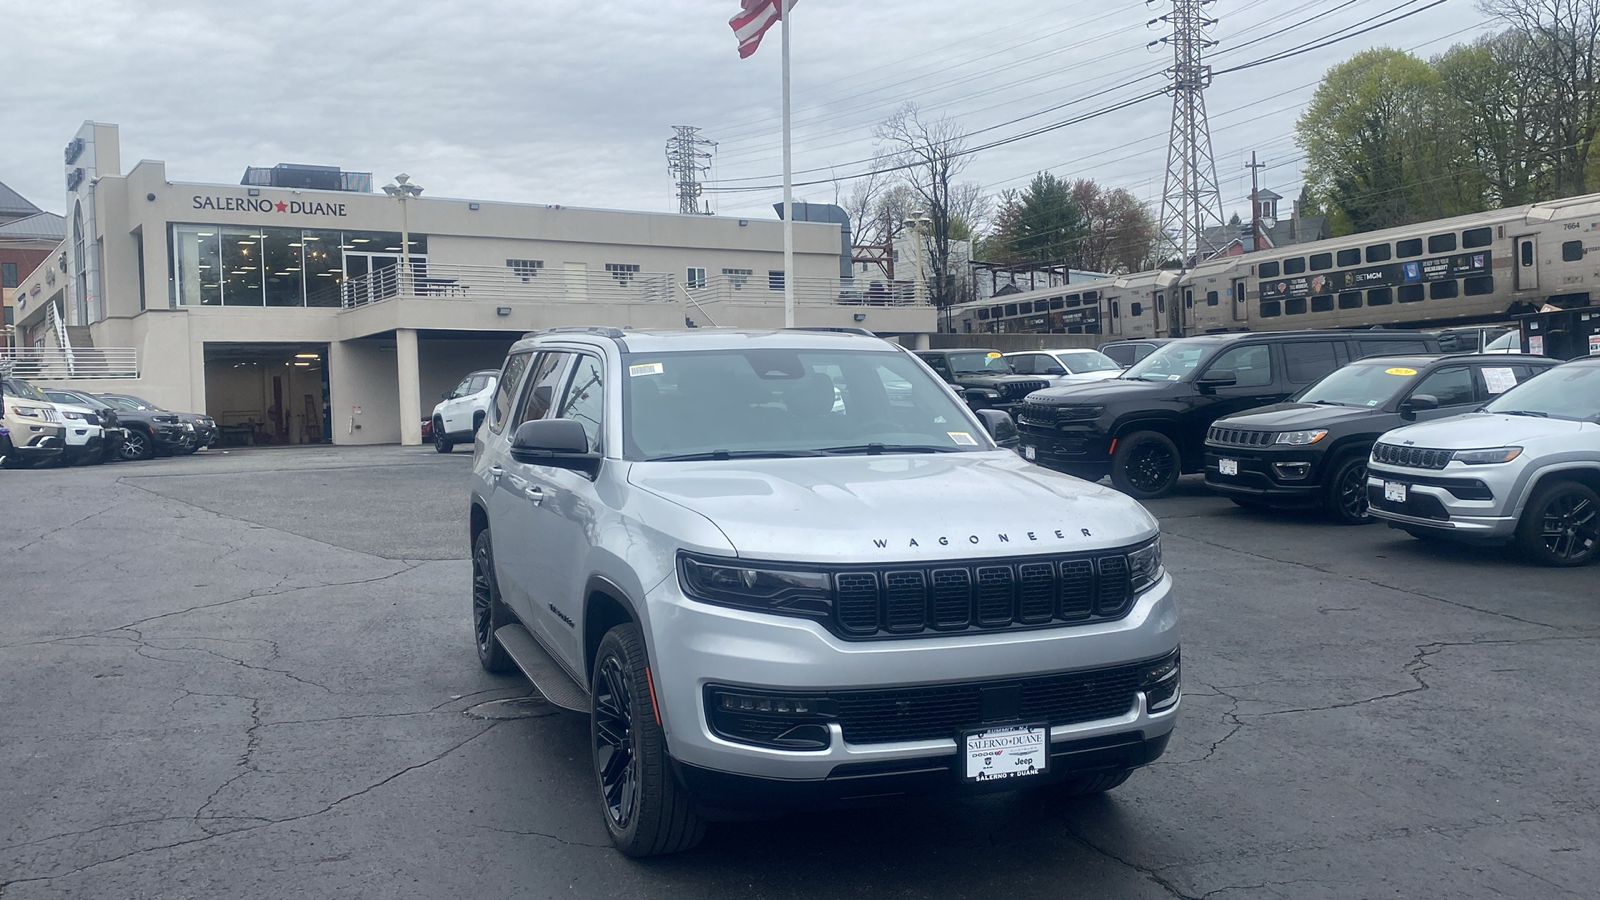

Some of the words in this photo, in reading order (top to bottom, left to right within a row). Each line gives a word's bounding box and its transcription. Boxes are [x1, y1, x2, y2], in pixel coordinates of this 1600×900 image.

[193, 196, 273, 212] SALERNO
[290, 201, 347, 216] DUANE
[1563, 222, 1580, 230] 7664
[1356, 272, 1382, 281] BETMGM
[873, 528, 1091, 549] WAGONEER
[968, 738, 1008, 750] SALERNO
[1012, 734, 1043, 745] DUANE
[1015, 757, 1033, 766] Jeep
[976, 773, 1007, 782] SALERNO
